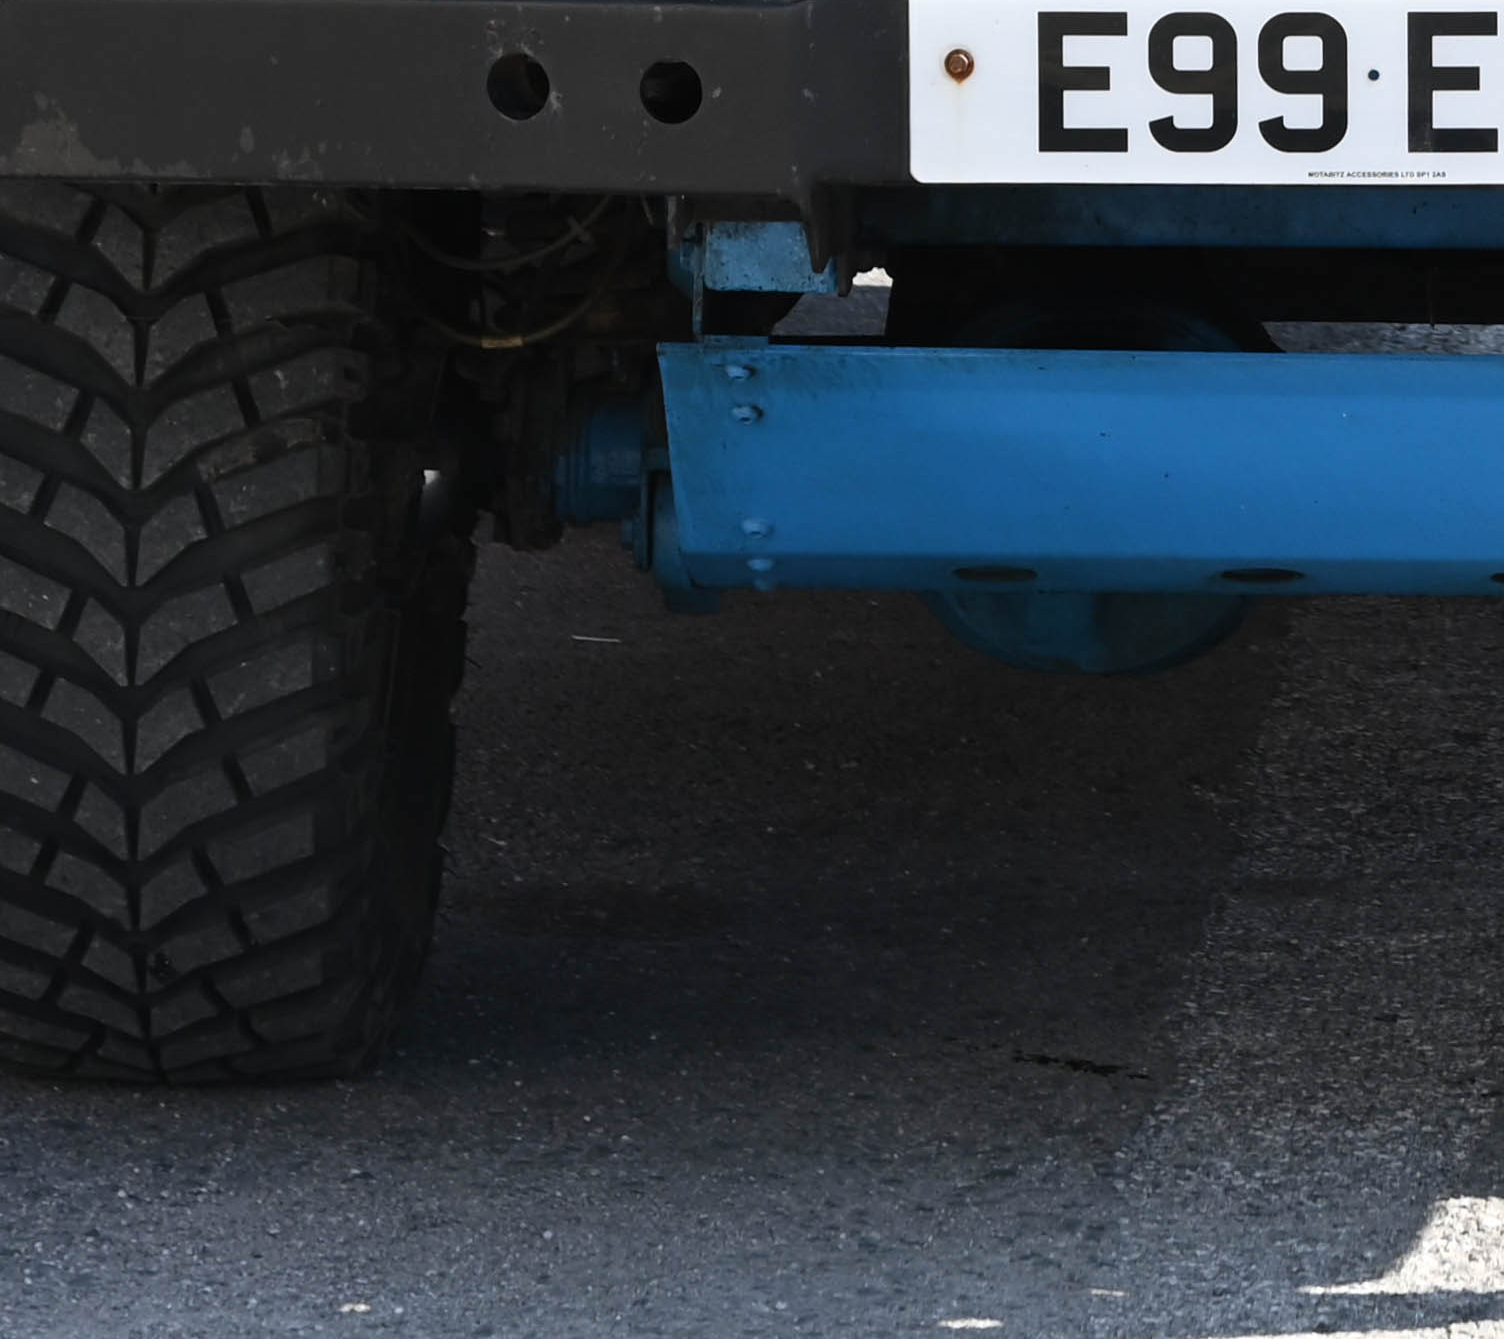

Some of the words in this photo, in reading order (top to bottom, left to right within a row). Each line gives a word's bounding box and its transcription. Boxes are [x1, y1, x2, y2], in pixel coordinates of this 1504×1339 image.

[1037, 10, 1348, 153] E99
[1346, 170, 1399, 179] ACCESSORIES
[1401, 170, 1415, 179] LTD
